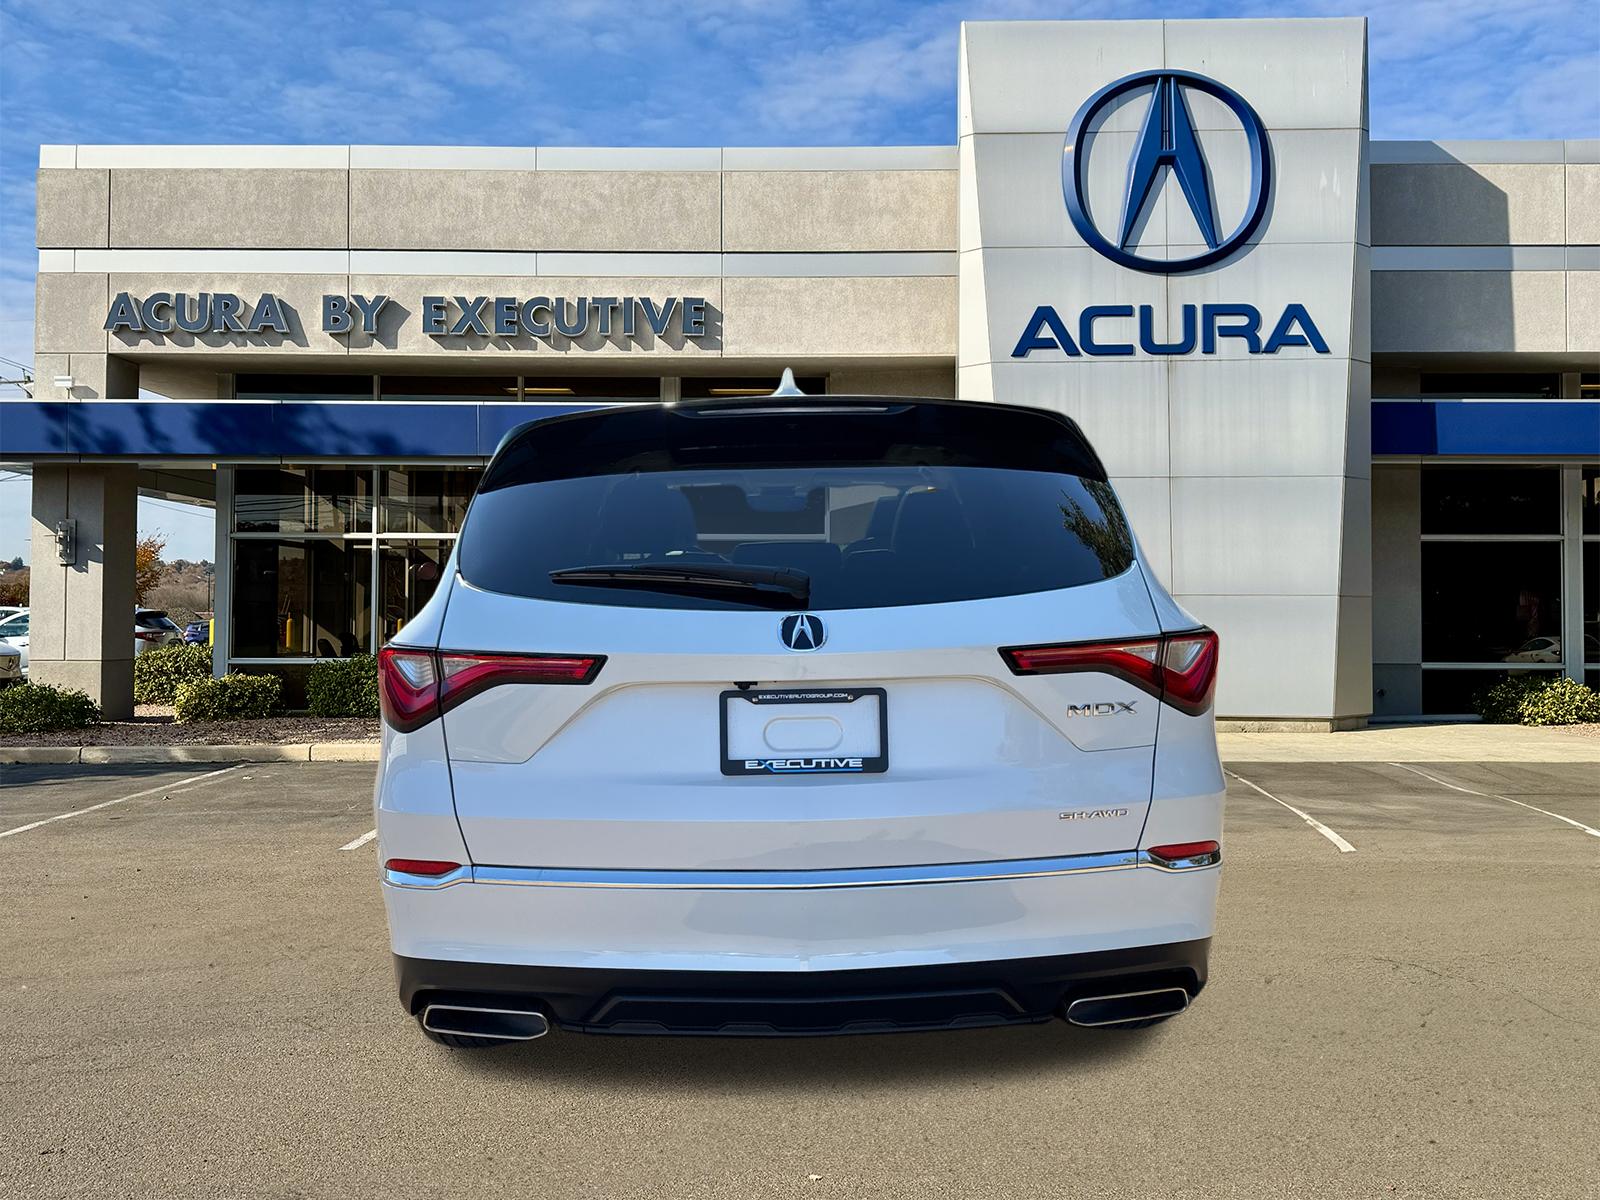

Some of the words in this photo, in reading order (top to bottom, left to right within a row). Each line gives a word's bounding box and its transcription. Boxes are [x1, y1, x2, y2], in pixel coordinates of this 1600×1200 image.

[103, 292, 290, 333] ACURA
[322, 294, 391, 334] BY
[422, 296, 706, 337] EXECUTIVE
[1011, 303, 1331, 357] ACURA
[758, 692, 849, 700] EXECUTIVEAUTOGROUP.COM
[1066, 700, 1139, 718] MDX
[744, 758, 864, 770] EXECUTIVE
